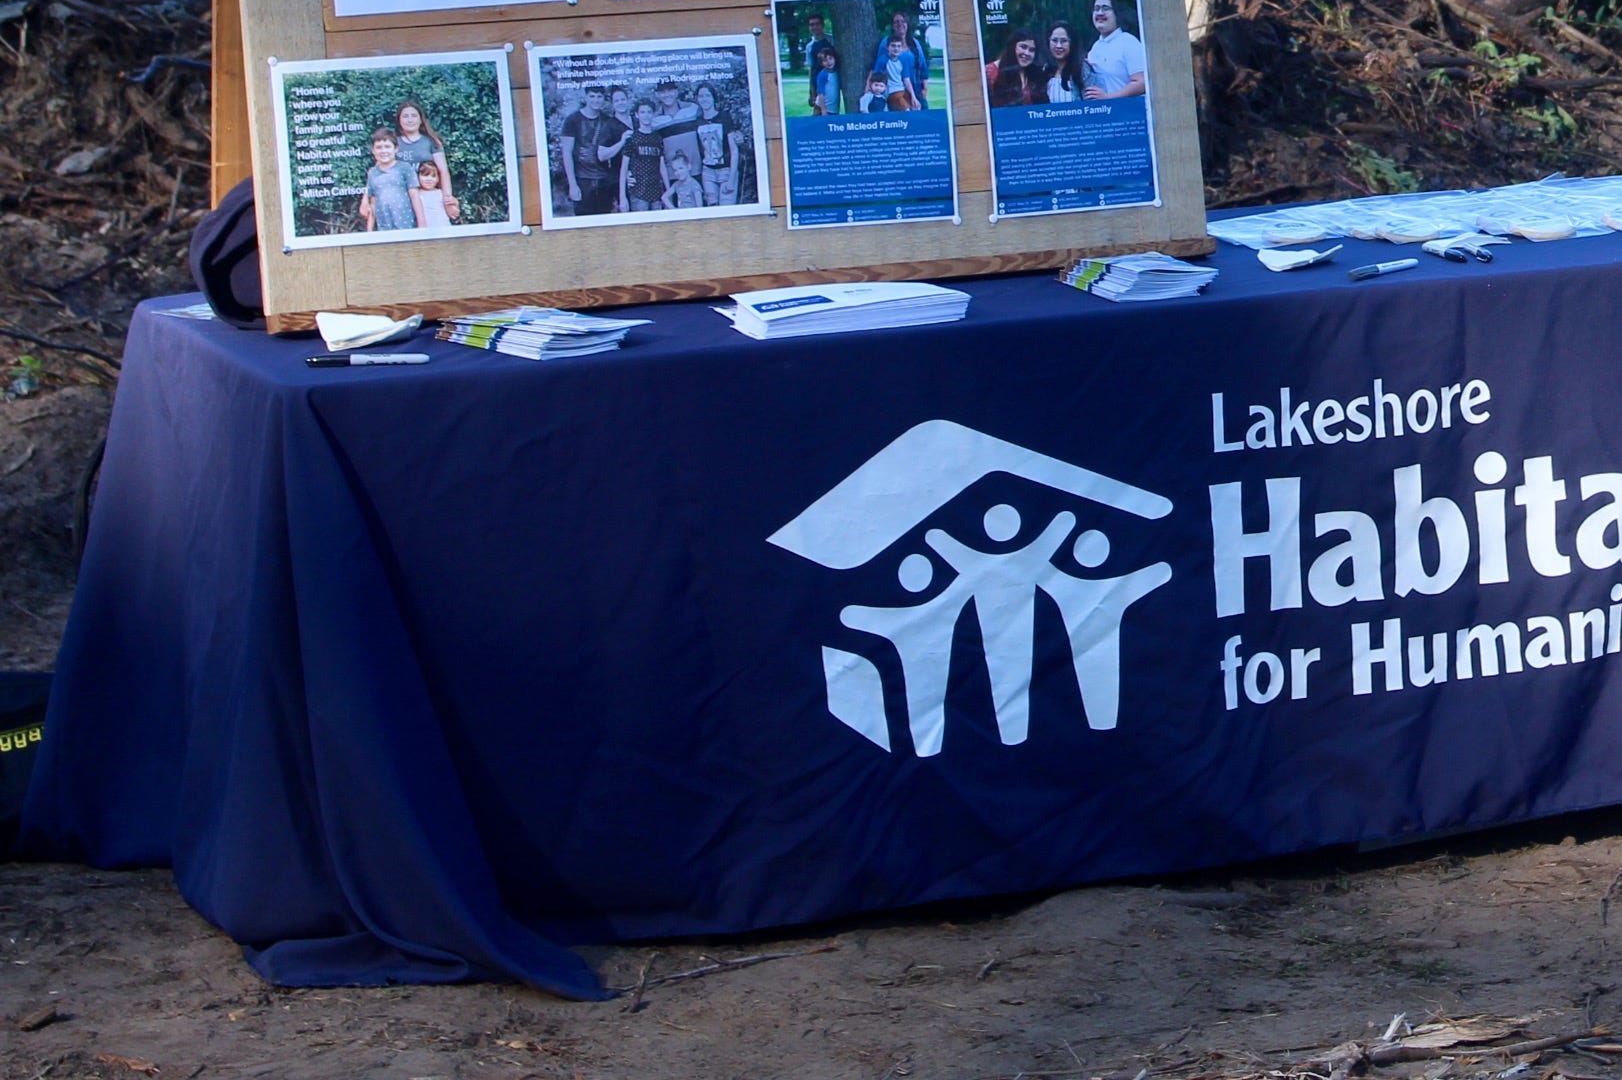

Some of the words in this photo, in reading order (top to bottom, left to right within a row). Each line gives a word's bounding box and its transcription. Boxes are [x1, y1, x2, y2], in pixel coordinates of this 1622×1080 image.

[620, 56, 633, 64] this
[668, 54, 688, 62] place
[557, 70, 583, 78] infinite
[585, 68, 624, 77] happiness
[647, 64, 685, 72] wonderful
[686, 62, 730, 70] harmonious
[326, 86, 334, 94] is
[293, 101, 322, 109] where
[324, 99, 341, 108] you
[294, 114, 318, 123] grow
[319, 112, 340, 121] your
[1028, 110, 1043, 119] The
[1046, 108, 1082, 118] Zermeno
[1084, 105, 1112, 115] Family
[295, 126, 323, 135] family
[325, 123, 342, 132] and
[828, 123, 844, 132] The
[847, 122, 878, 131] Mcleod
[880, 120, 908, 130] Family
[296, 139, 308, 147] so
[309, 136, 345, 147] greatful
[297, 150, 331, 160] Habitat
[333, 147, 361, 156] would
[298, 164, 332, 174] partner
[299, 176, 319, 185] with
[300, 188, 330, 198] -Mitch
[331, 187, 368, 196] Carlson
[1212, 378, 1491, 453] Lakeshore
[1221, 635, 1320, 710] for
